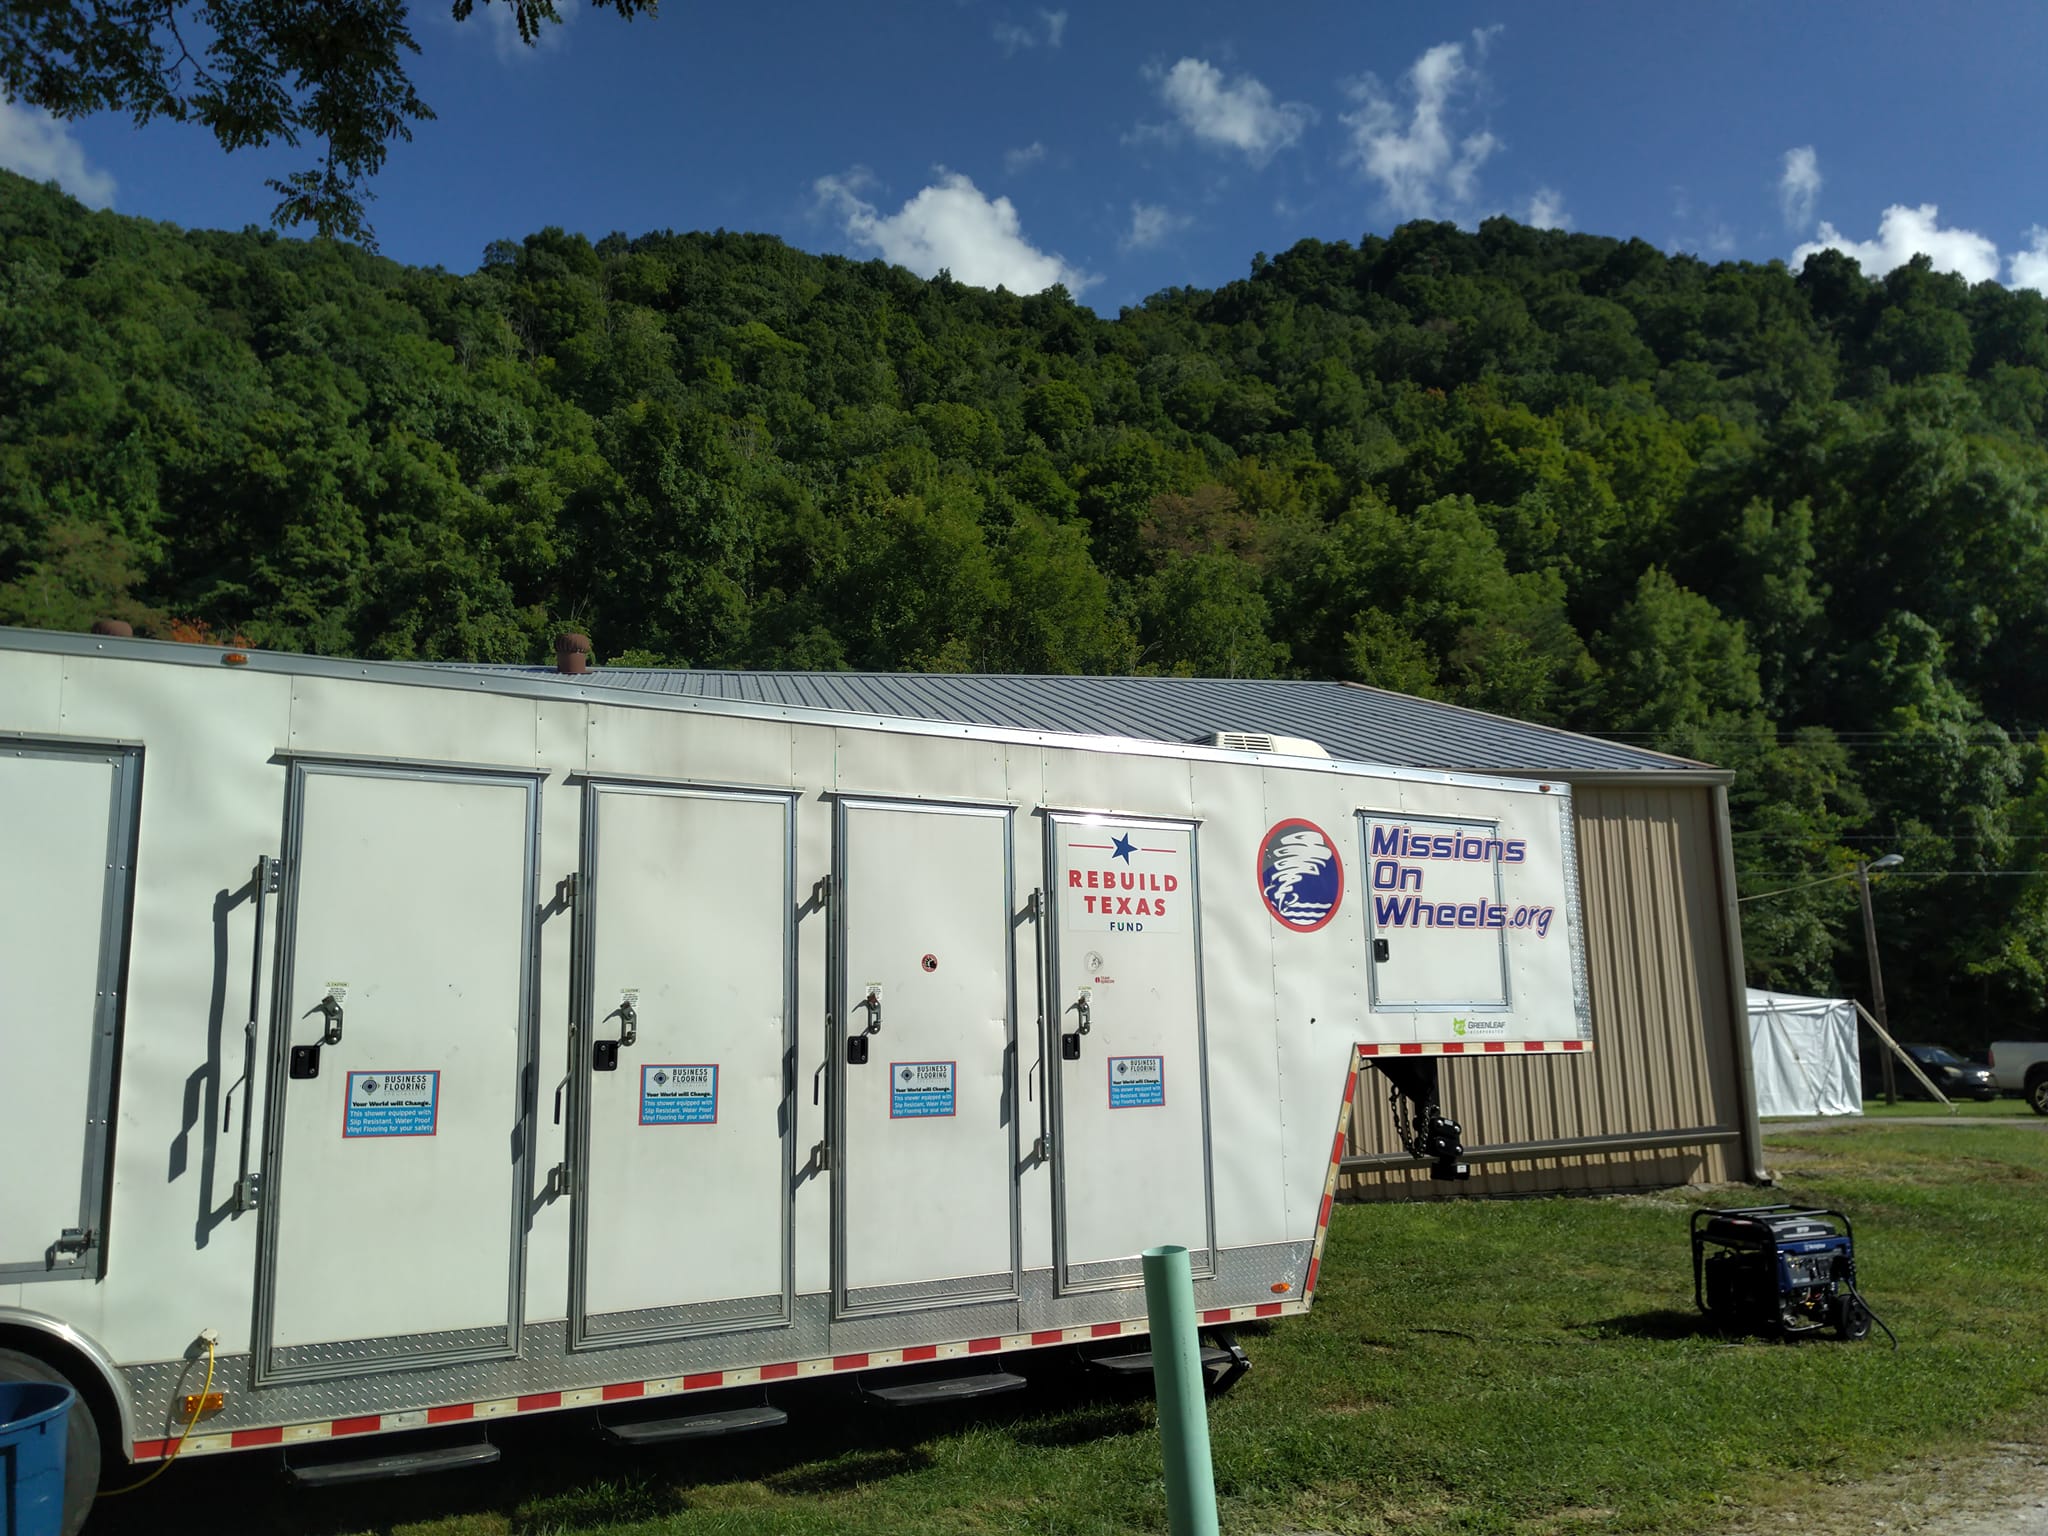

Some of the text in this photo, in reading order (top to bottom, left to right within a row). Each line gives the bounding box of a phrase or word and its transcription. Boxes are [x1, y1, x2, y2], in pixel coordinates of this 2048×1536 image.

[1371, 825, 1527, 864] Missions
[1069, 870, 1178, 892] REBUILD
[1373, 860, 1423, 892] On
[1084, 896, 1166, 916] TEXAS
[1374, 895, 1555, 939] Wheels.org
[1110, 922, 1143, 932] FUND
